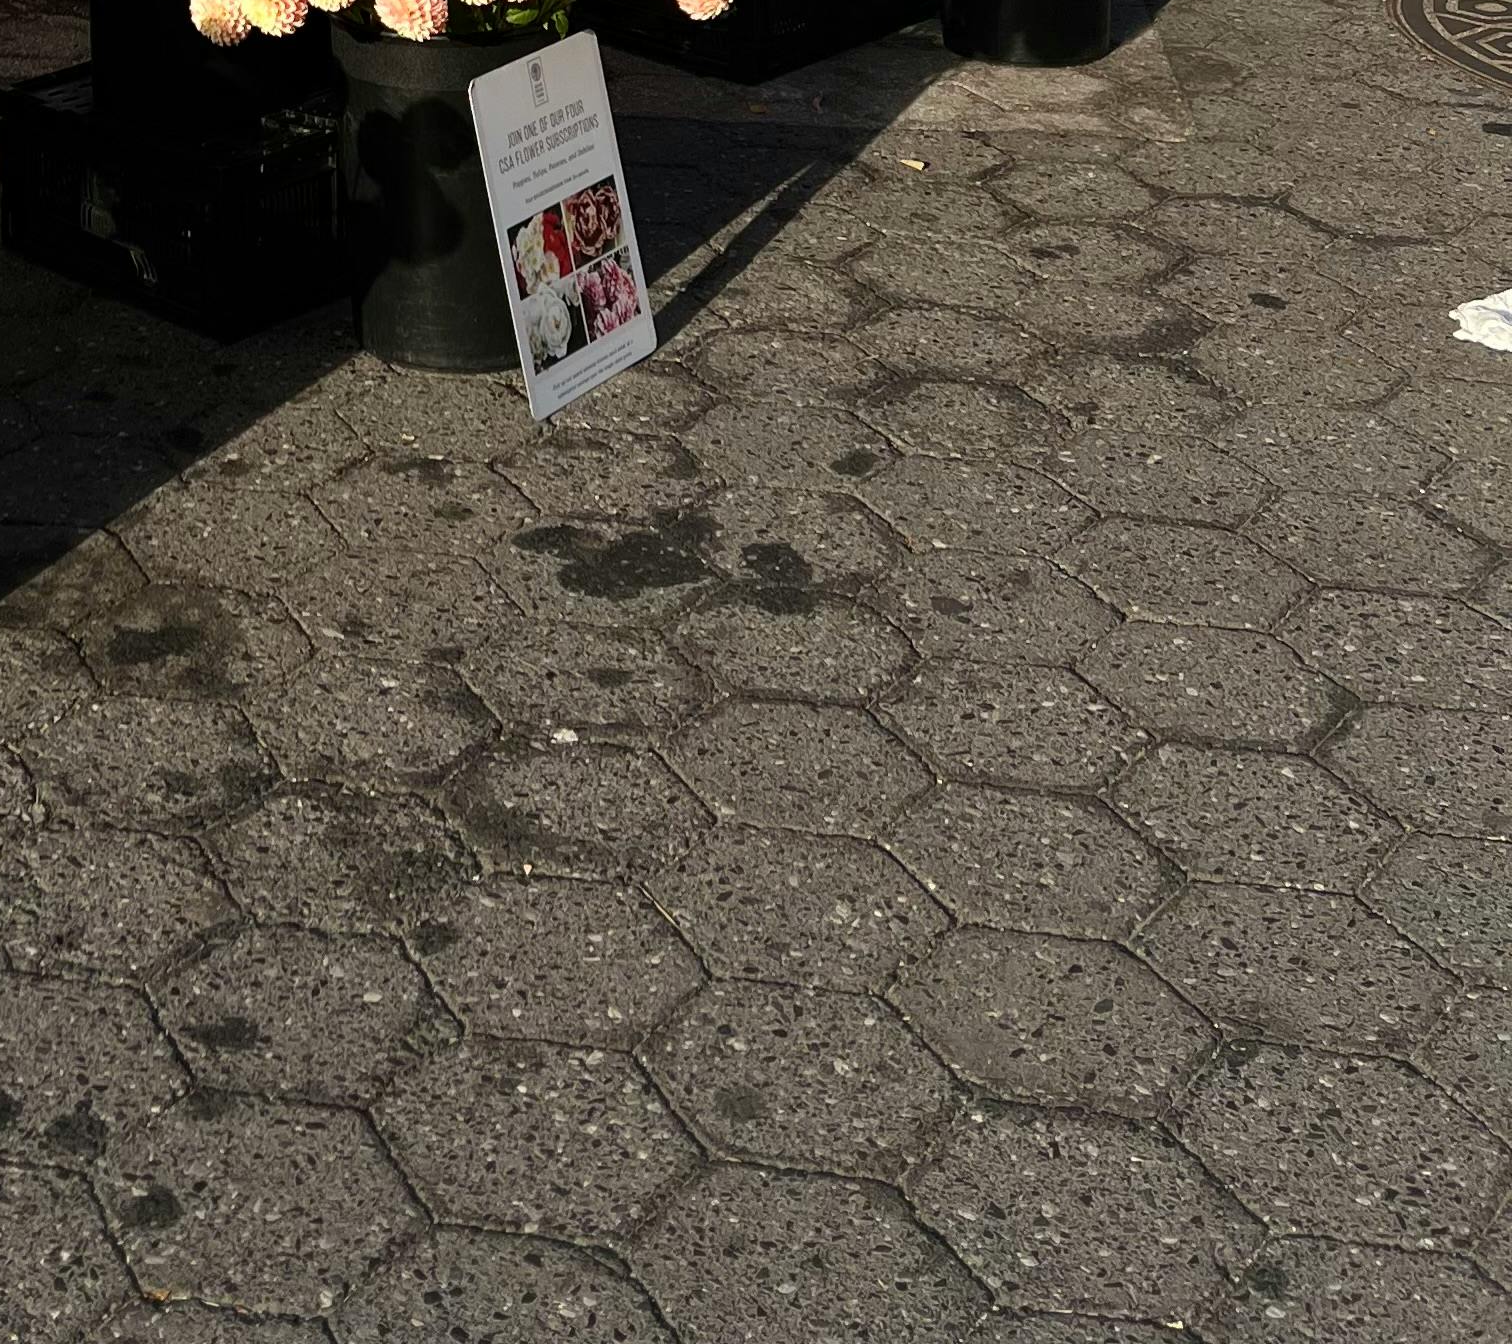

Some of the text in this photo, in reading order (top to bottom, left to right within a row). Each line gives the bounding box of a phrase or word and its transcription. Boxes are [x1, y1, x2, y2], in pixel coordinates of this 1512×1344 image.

[498, 113, 600, 174] CSA FLOWER SUBSCRIPTIONS
[507, 99, 585, 149] JOIN ONE OF OUR FOUR
